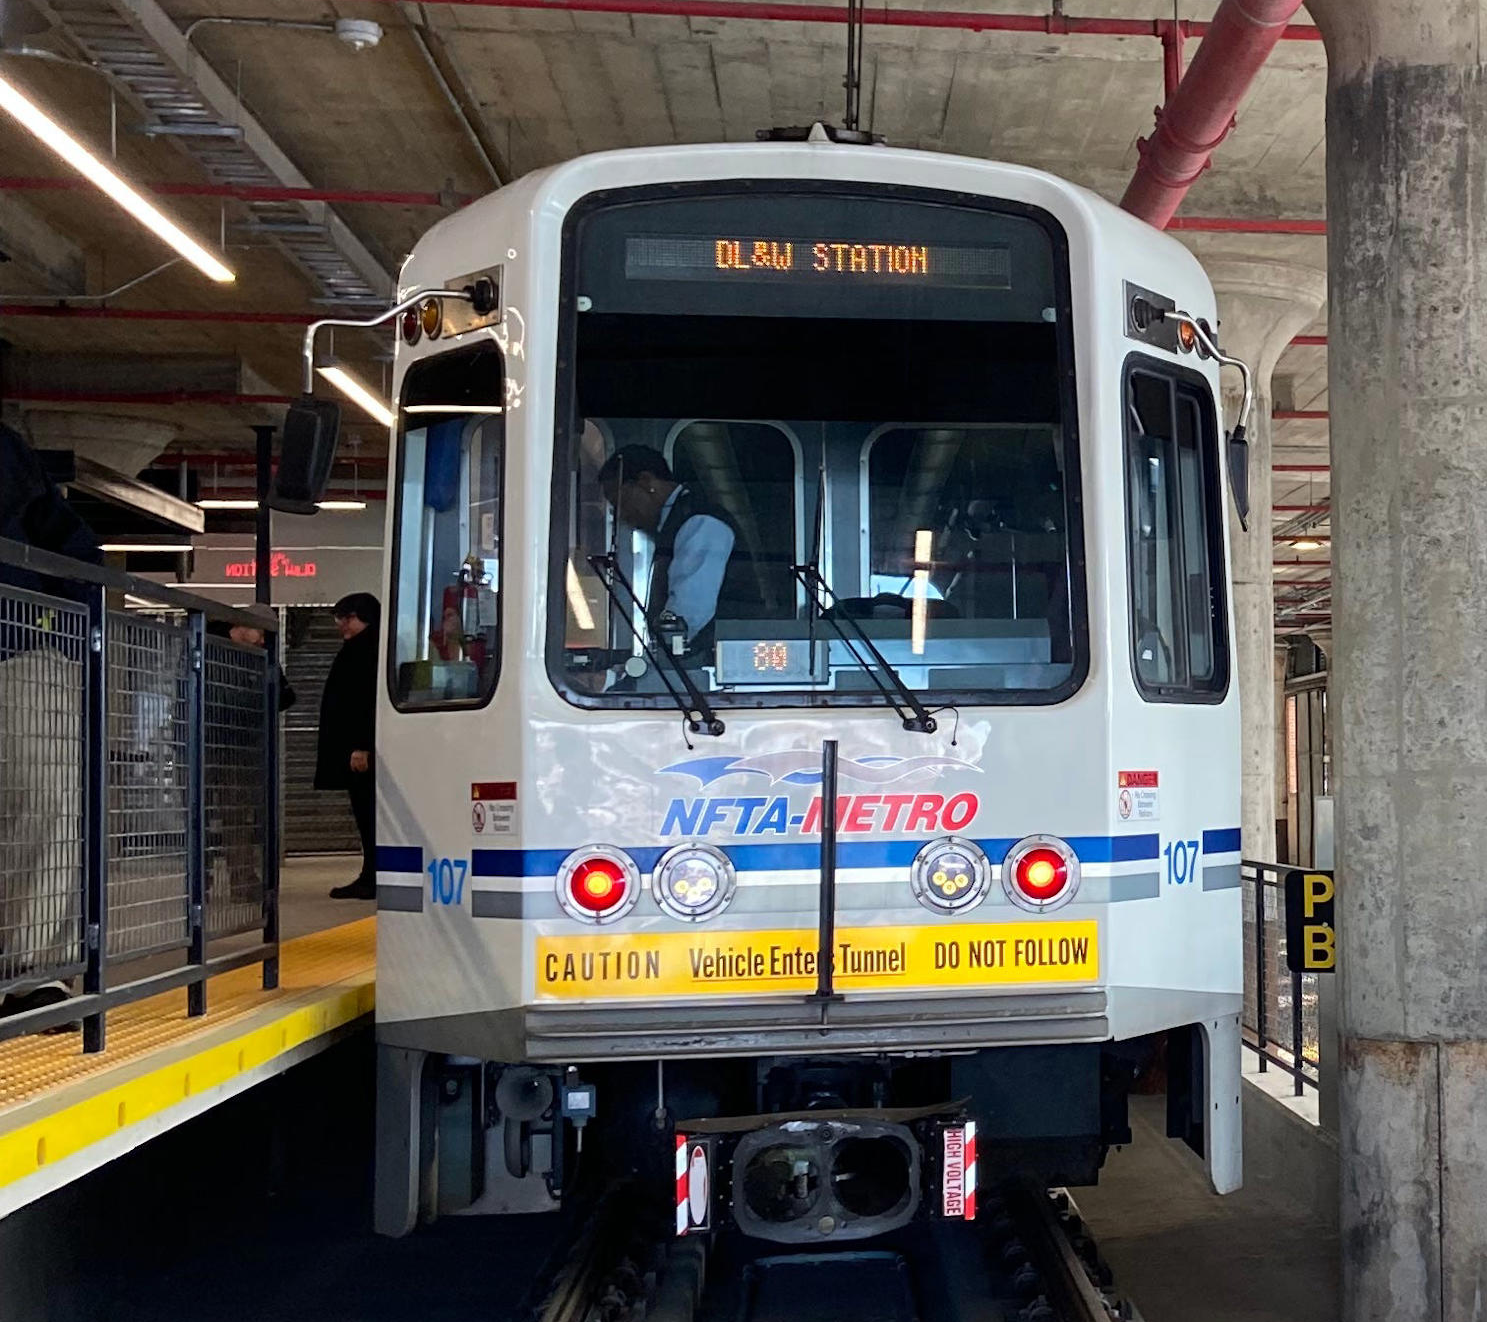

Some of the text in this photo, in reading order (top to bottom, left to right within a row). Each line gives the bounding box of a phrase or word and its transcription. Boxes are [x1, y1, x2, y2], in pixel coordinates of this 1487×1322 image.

[715, 240, 929, 274] DL&W STATION
[427, 858, 468, 906] 107
[1163, 839, 1200, 885] 107
[545, 937, 1090, 982] CAUTION Vehicle Ente Tunnel DO NOT FOLLOW
[946, 1128, 962, 1215] HIGH VOLTAGE
